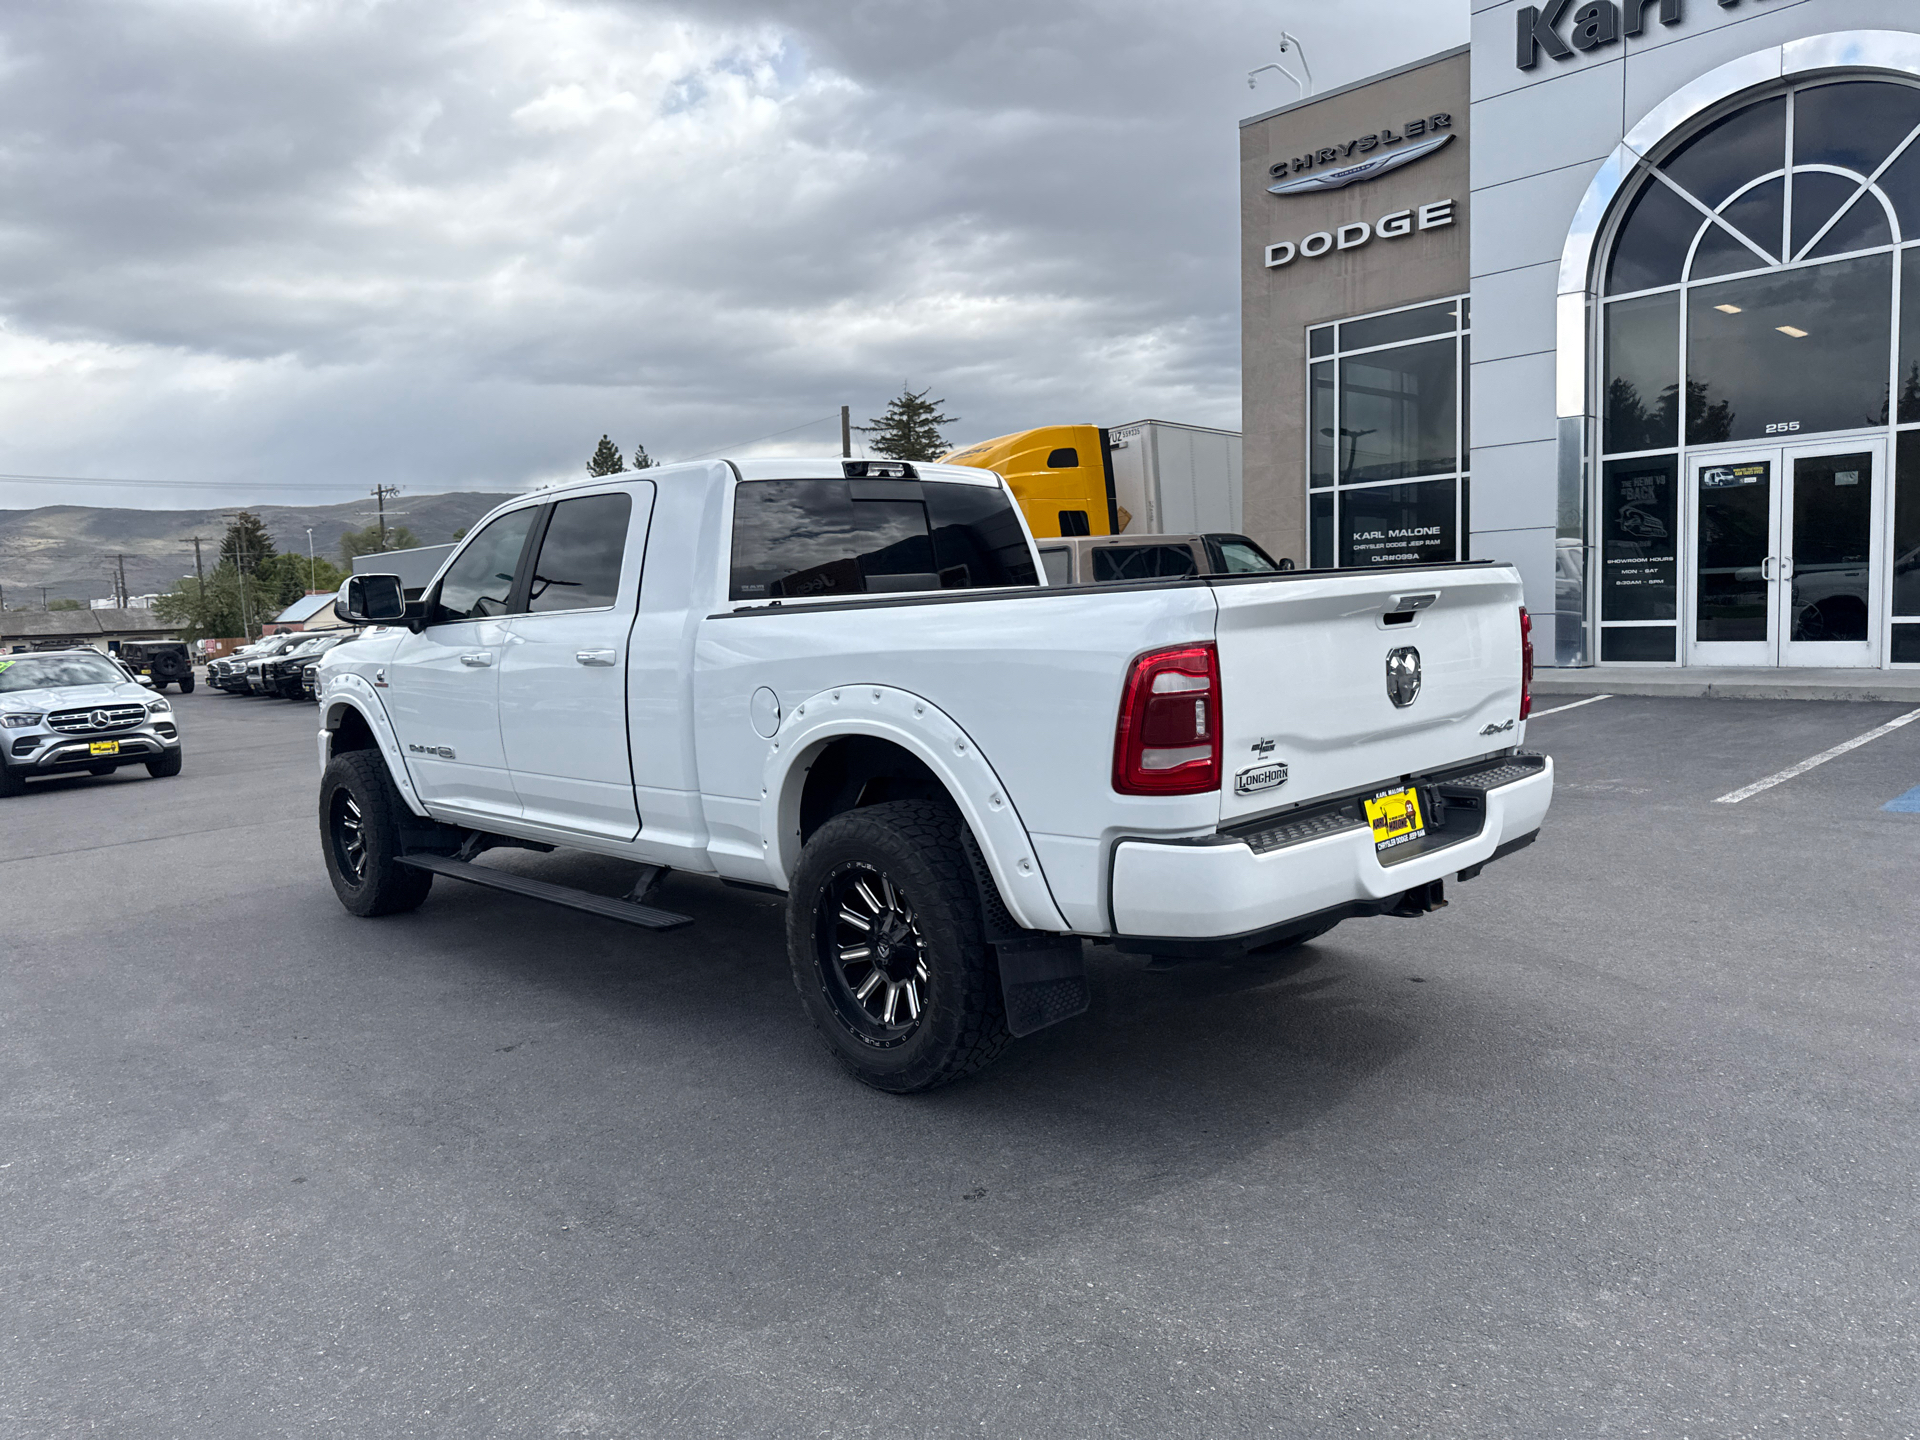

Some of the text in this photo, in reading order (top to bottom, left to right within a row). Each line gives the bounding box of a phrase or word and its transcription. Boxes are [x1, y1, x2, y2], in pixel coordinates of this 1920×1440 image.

[1269, 112, 1452, 178] CHRYSLER
[1265, 198, 1456, 269] DODGE
[1765, 421, 1800, 434] 255
[1109, 431, 1122, 443] UZ
[1627, 486, 1655, 500] BACK
[1353, 526, 1440, 540] KARL MALONE
[1388, 786, 1405, 796] MALONE
[1389, 817, 1408, 832] MALONE
